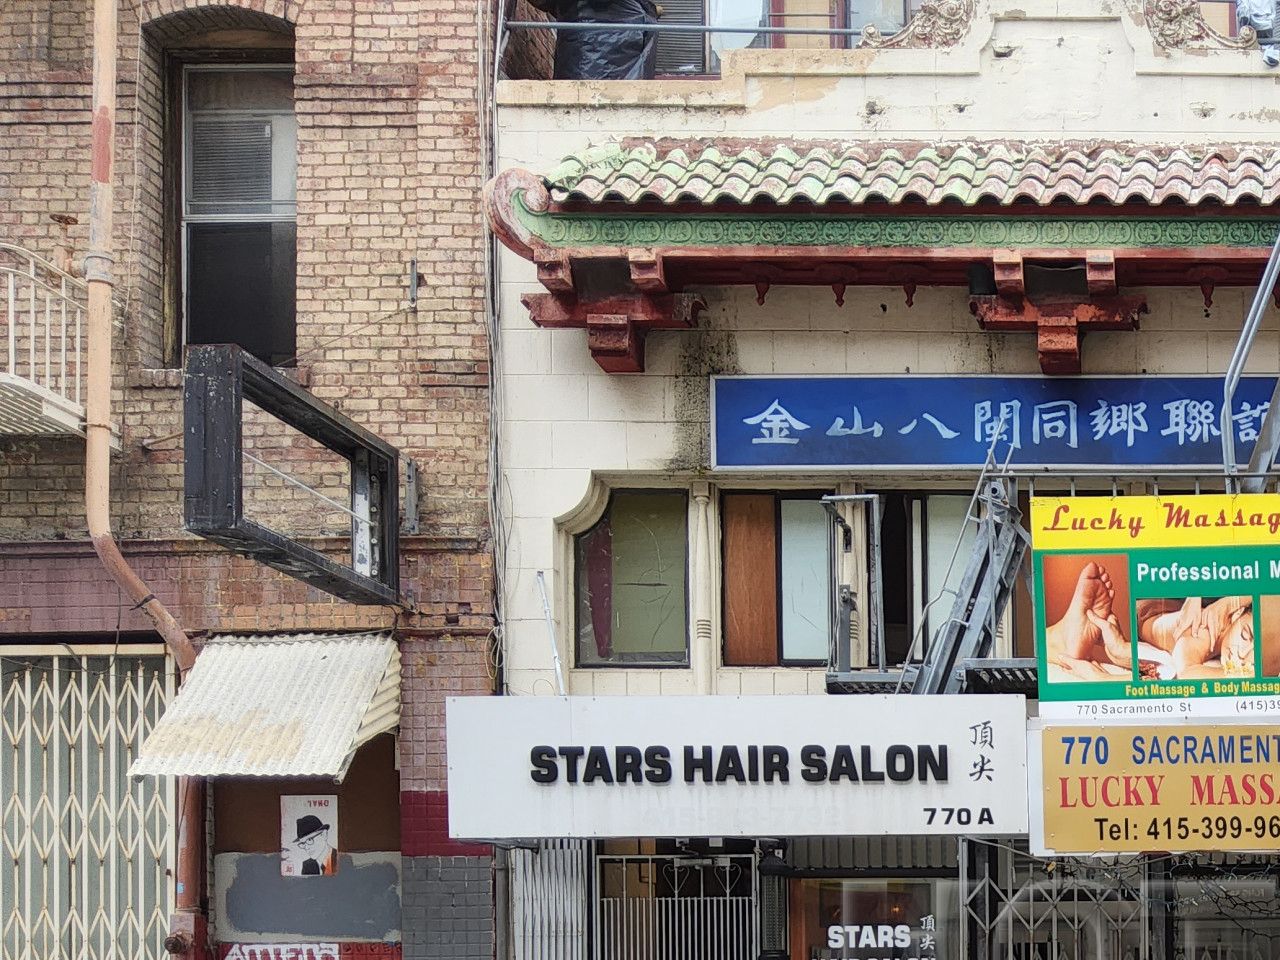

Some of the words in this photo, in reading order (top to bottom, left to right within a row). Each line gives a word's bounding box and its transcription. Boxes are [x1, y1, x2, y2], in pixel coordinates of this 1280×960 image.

[1043, 504, 1146, 538] Lucky
[1137, 561, 1260, 582] Professional
[1126, 688, 1149, 698] Foot
[1150, 685, 1196, 698] Massage
[1202, 686, 1209, 697] &
[1214, 685, 1240, 698] Body
[1077, 706, 1098, 715] 770
[1101, 704, 1173, 715] Sacramento
[1179, 703, 1192, 713] St
[968, 719, 996, 782] 頂尖
[1061, 737, 1109, 764] 770
[530, 744, 673, 784] STARS
[684, 744, 790, 783] HAIR
[800, 743, 949, 783] SALON
[1059, 775, 1165, 808] LUCKY
[922, 808, 972, 825] 770
[976, 808, 995, 825] A
[1094, 818, 1139, 841] Tel:
[828, 925, 910, 948] STARS
[919, 914, 937, 950] 頂尖
